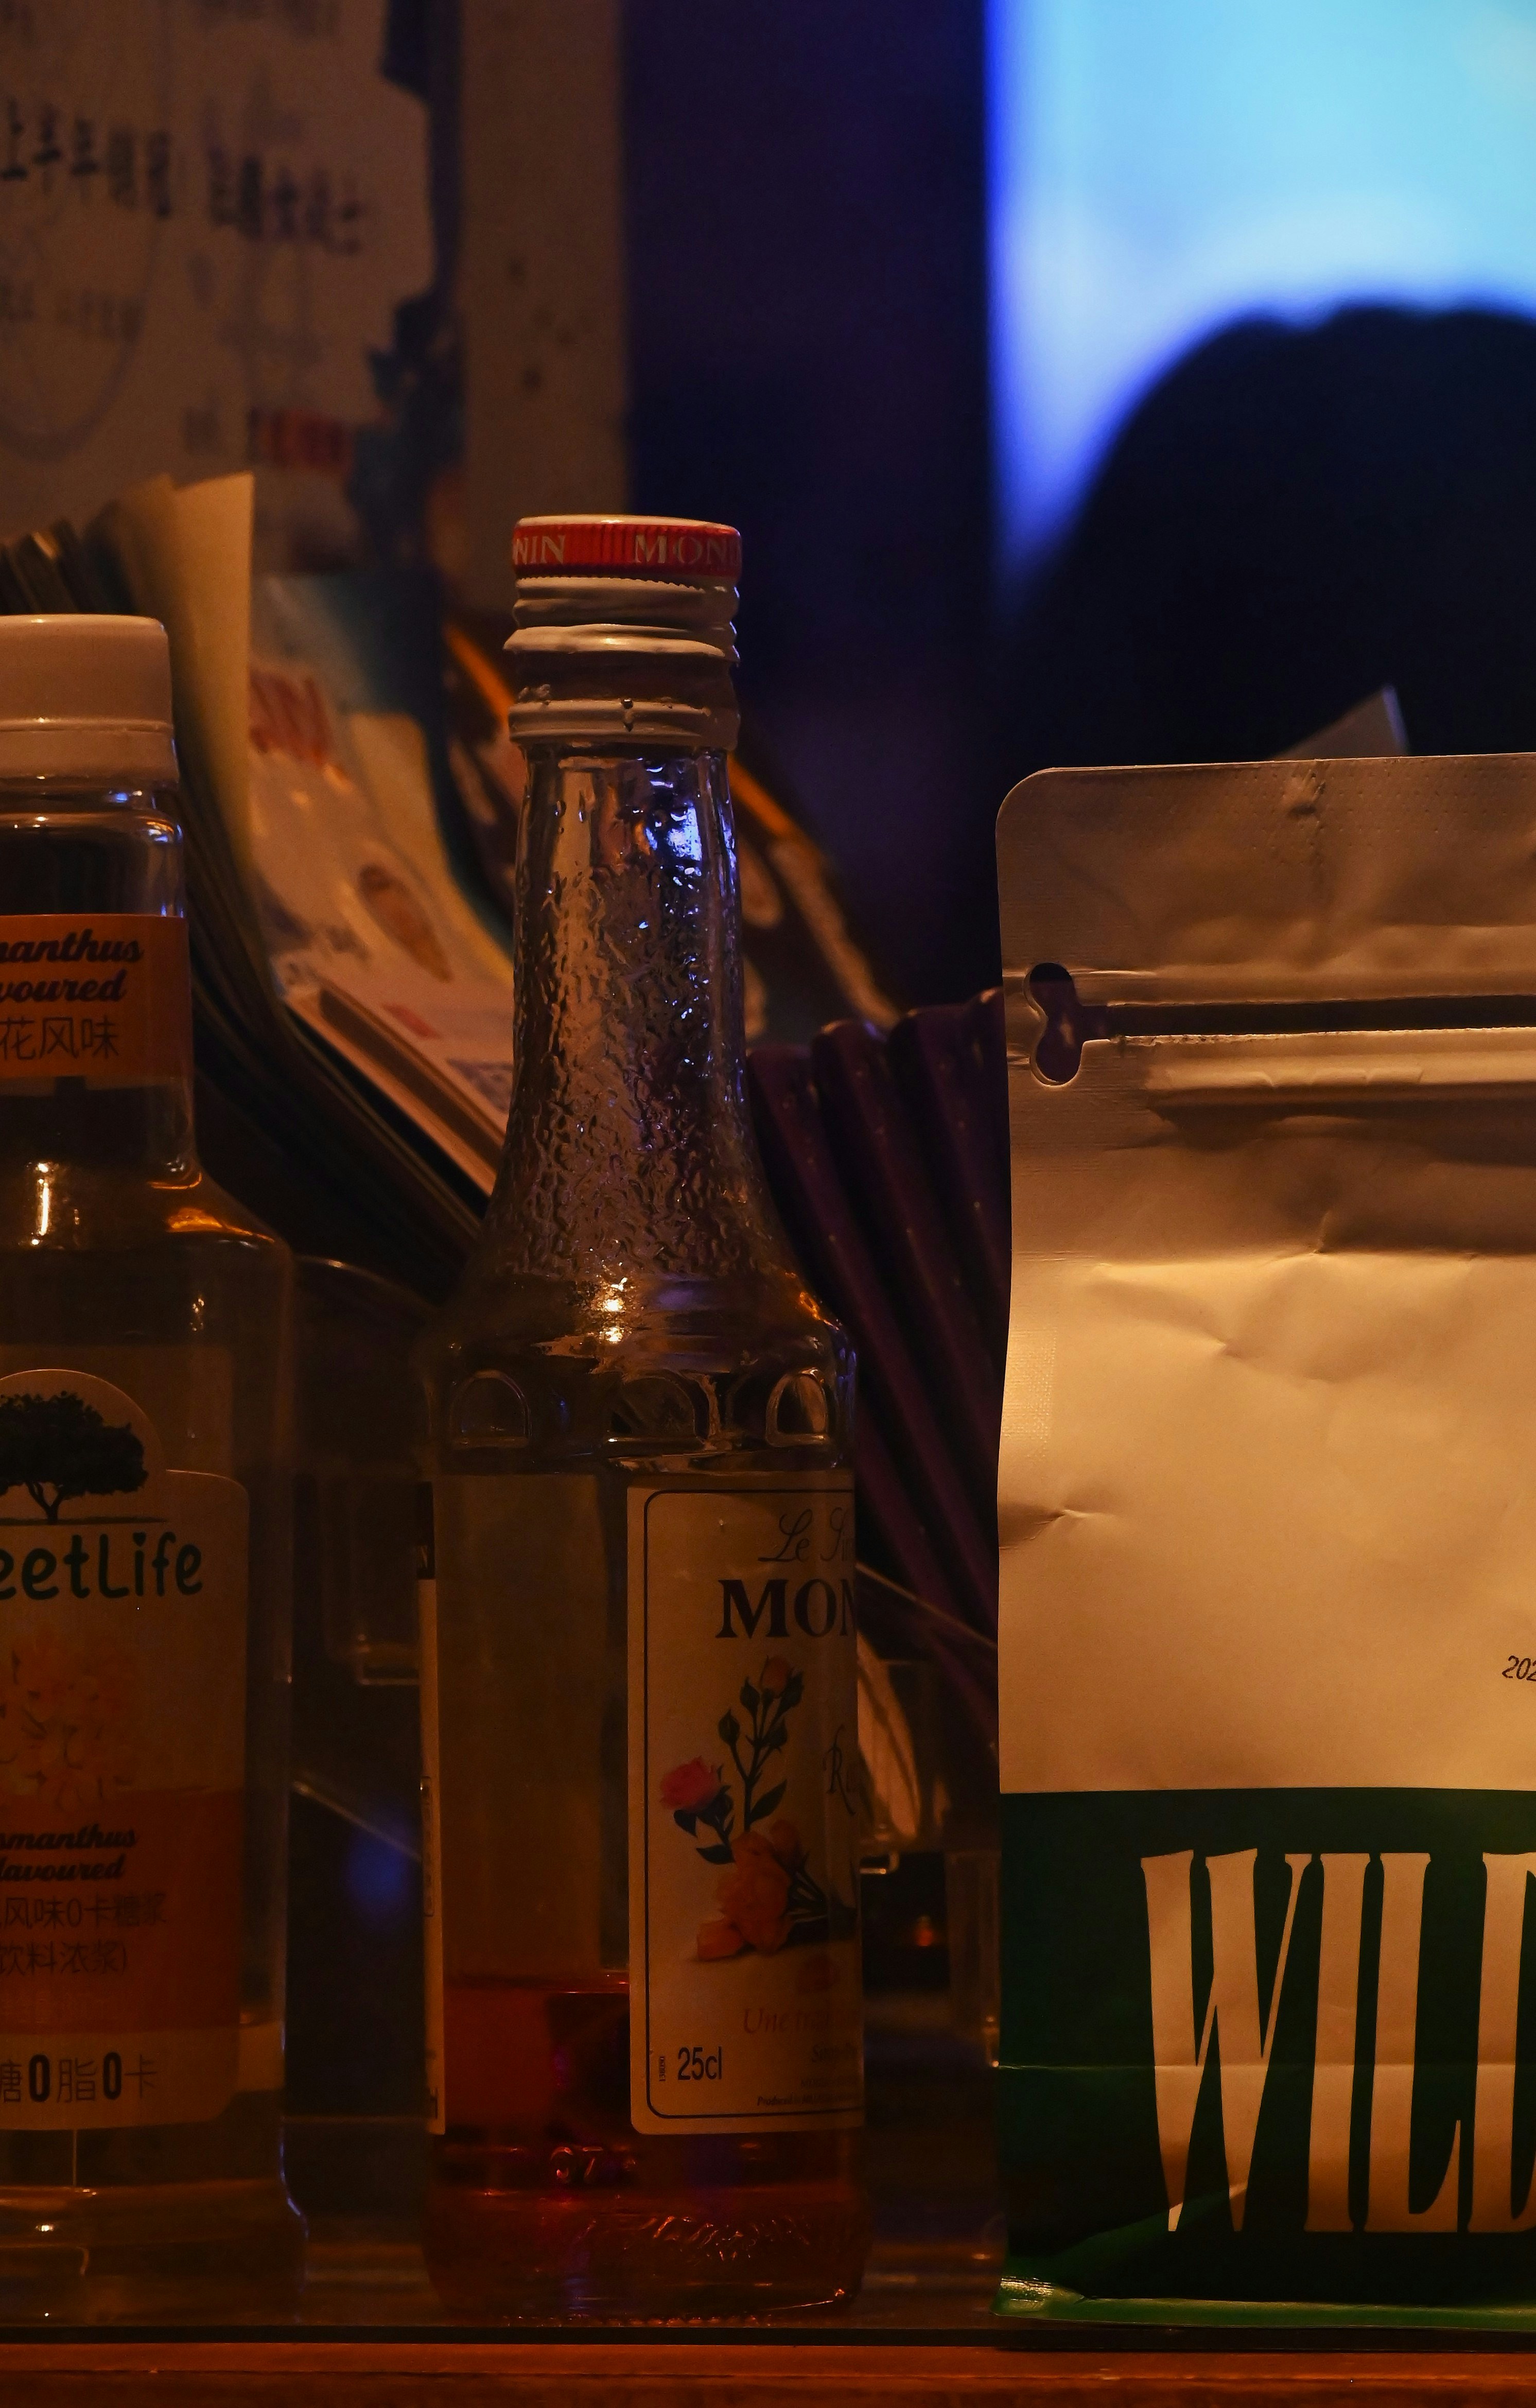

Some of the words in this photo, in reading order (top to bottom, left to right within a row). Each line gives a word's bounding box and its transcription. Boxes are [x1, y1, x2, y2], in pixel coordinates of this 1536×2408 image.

[0, 1016, 119, 1060] 花风味
[758, 1508, 811, 1562] Le
[677, 2046, 723, 2080] 25cl
